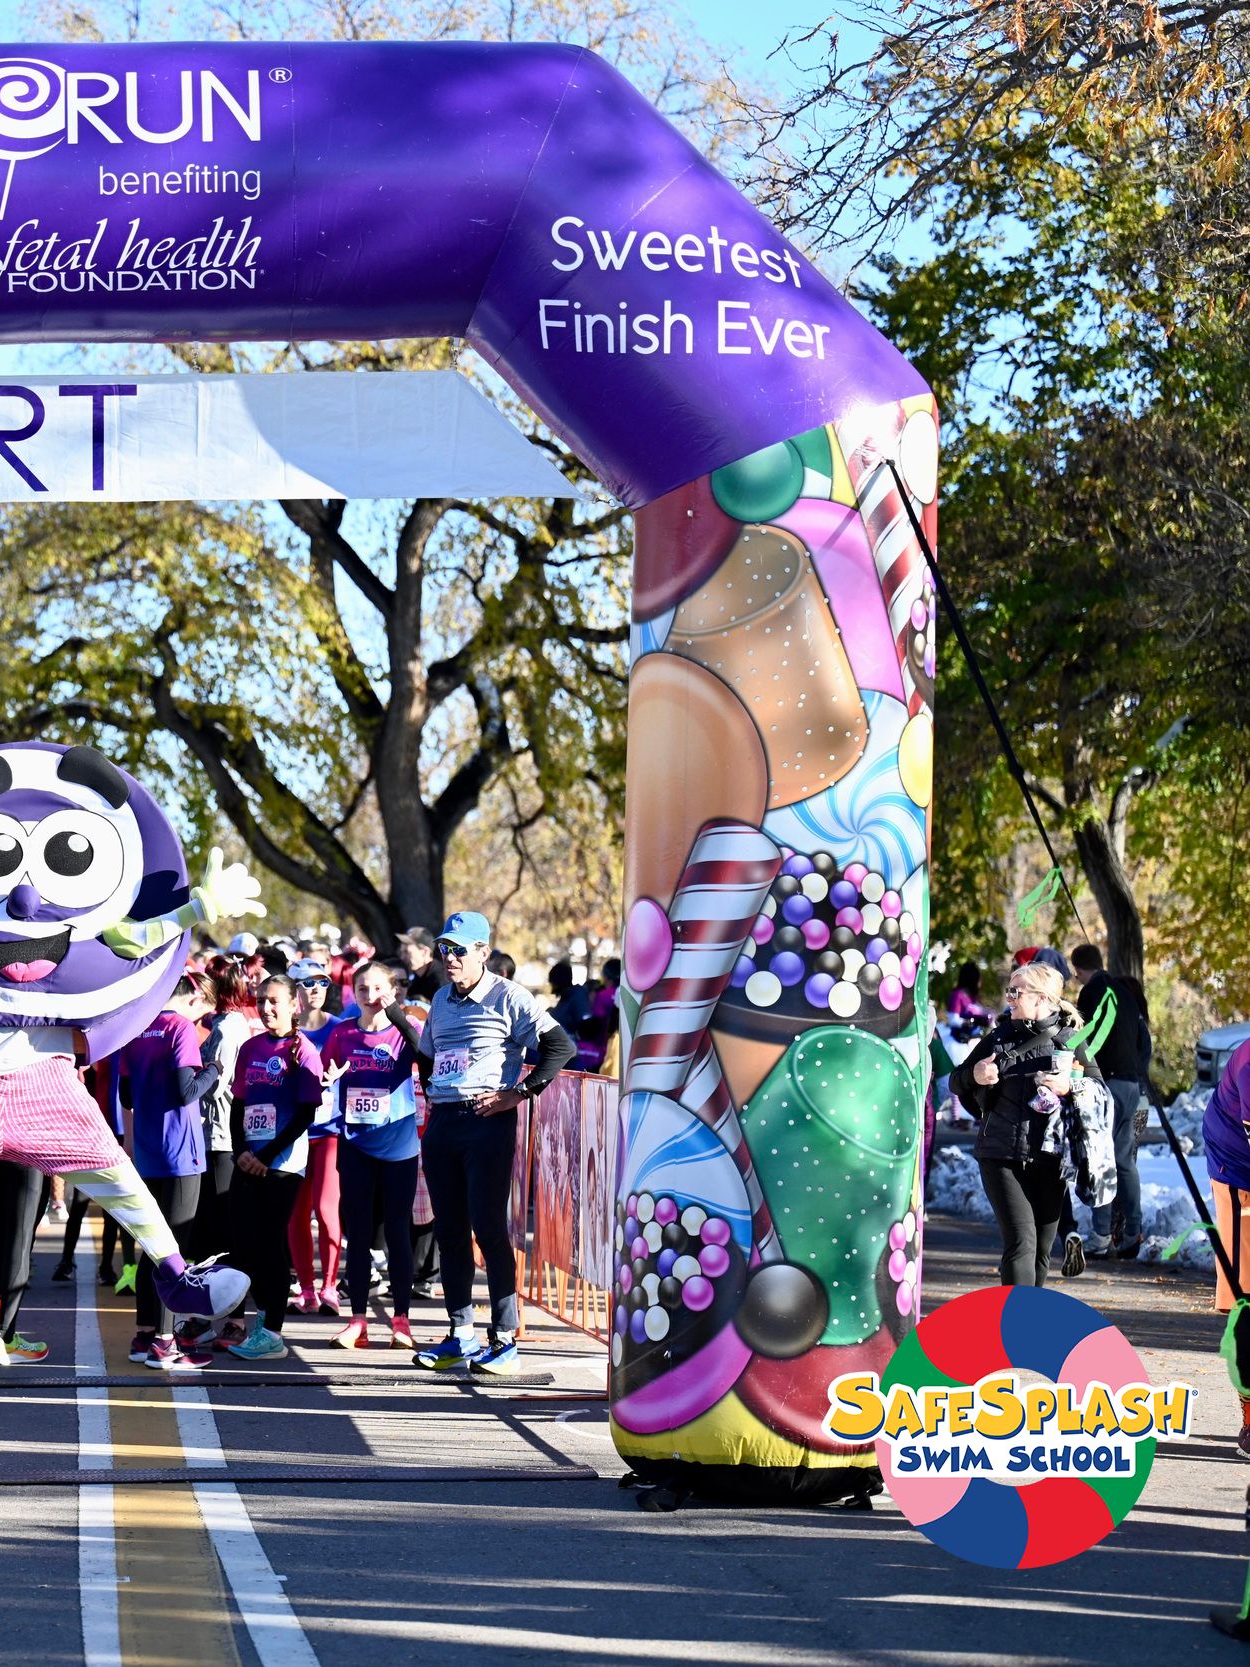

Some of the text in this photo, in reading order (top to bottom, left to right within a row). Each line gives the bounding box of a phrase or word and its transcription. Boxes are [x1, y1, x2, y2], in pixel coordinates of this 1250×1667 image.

[99, 163, 262, 200] benefiting
[1, 215, 262, 273] fetal health
[550, 215, 802, 289] Sweetest
[7, 269, 257, 293] FOUNDATION
[538, 298, 831, 360] Finish Ever
[438, 1059, 459, 1076] 534
[355, 1098, 380, 1113] 559
[247, 1114, 268, 1130] 362
